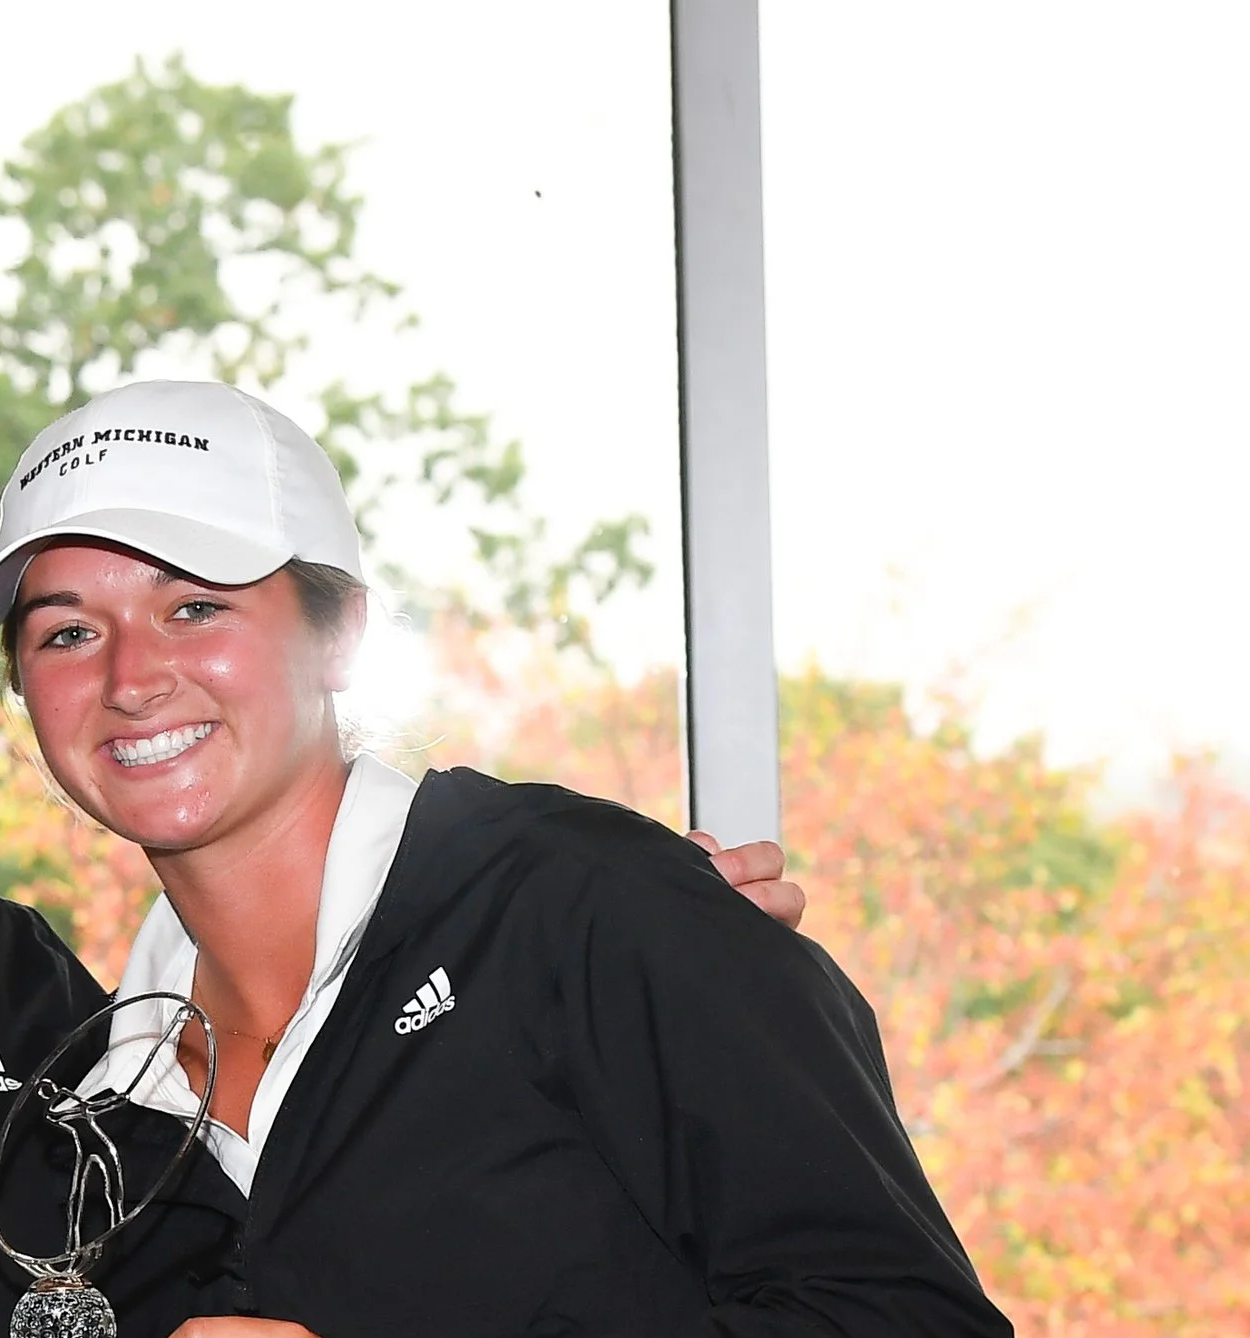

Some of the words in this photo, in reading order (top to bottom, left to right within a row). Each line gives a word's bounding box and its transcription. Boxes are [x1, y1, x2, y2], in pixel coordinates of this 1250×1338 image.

[20, 436, 85, 490] WESTERN
[91, 429, 210, 450] MICHIGAN
[59, 449, 107, 476] GOLF
[395, 995, 456, 1034] adidas
